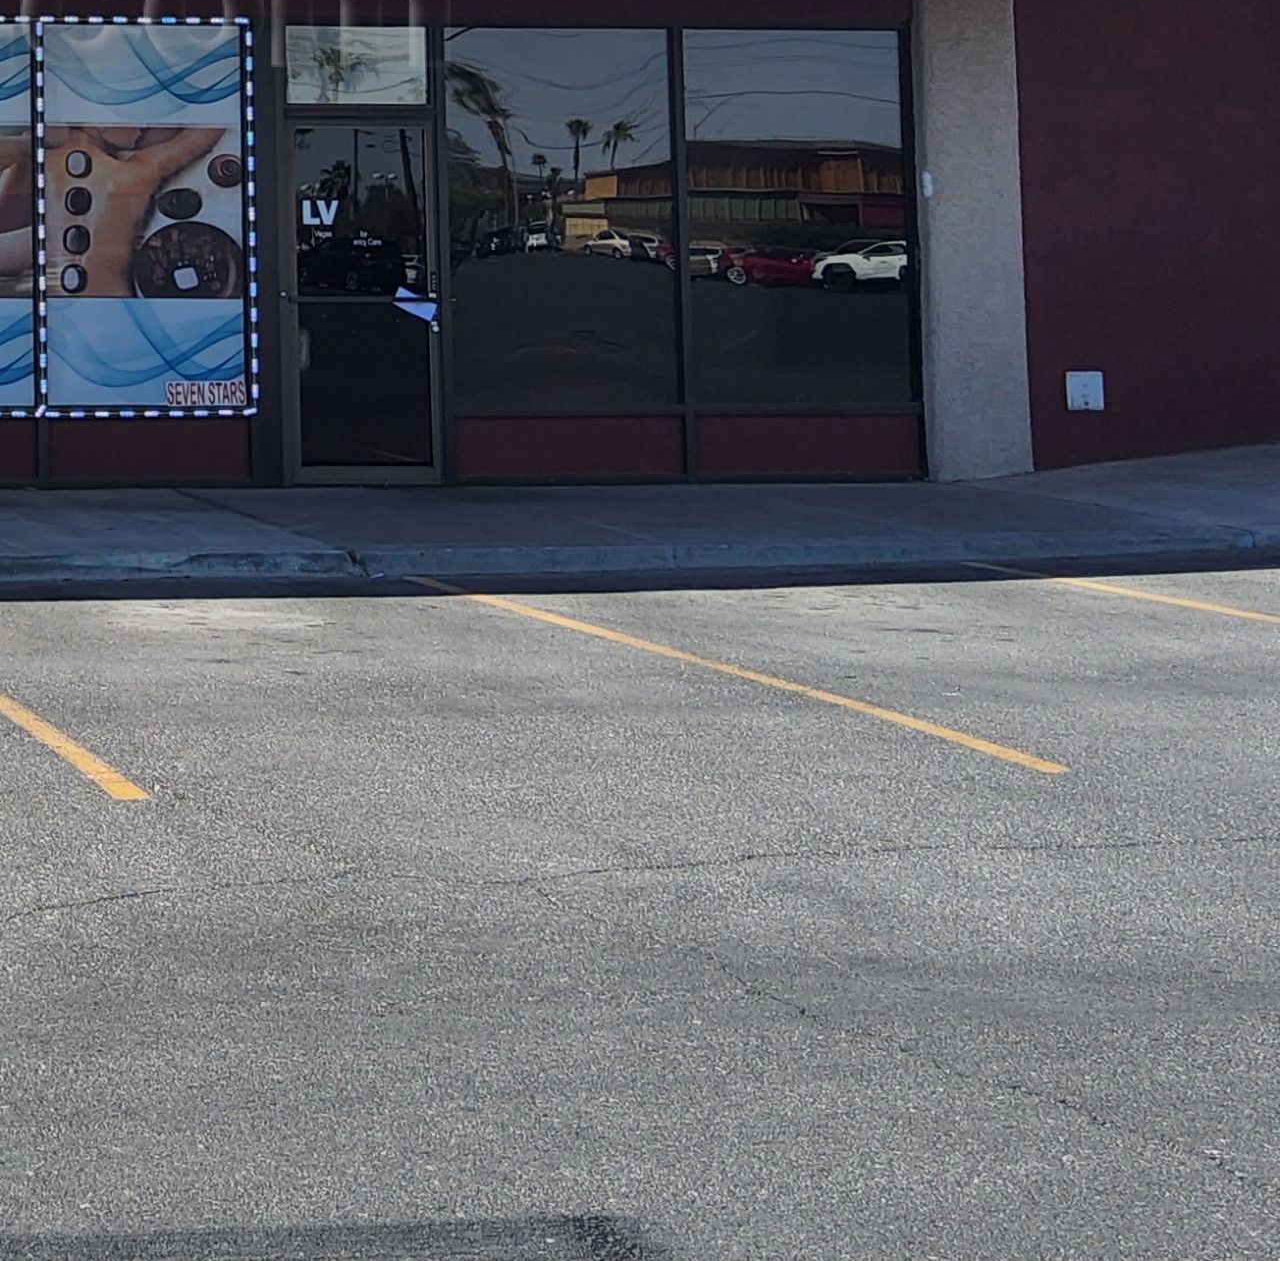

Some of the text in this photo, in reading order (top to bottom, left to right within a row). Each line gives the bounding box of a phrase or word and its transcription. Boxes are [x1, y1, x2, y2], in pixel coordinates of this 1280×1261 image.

[302, 200, 339, 225] LV
[167, 381, 246, 405] SEVEN STARS
